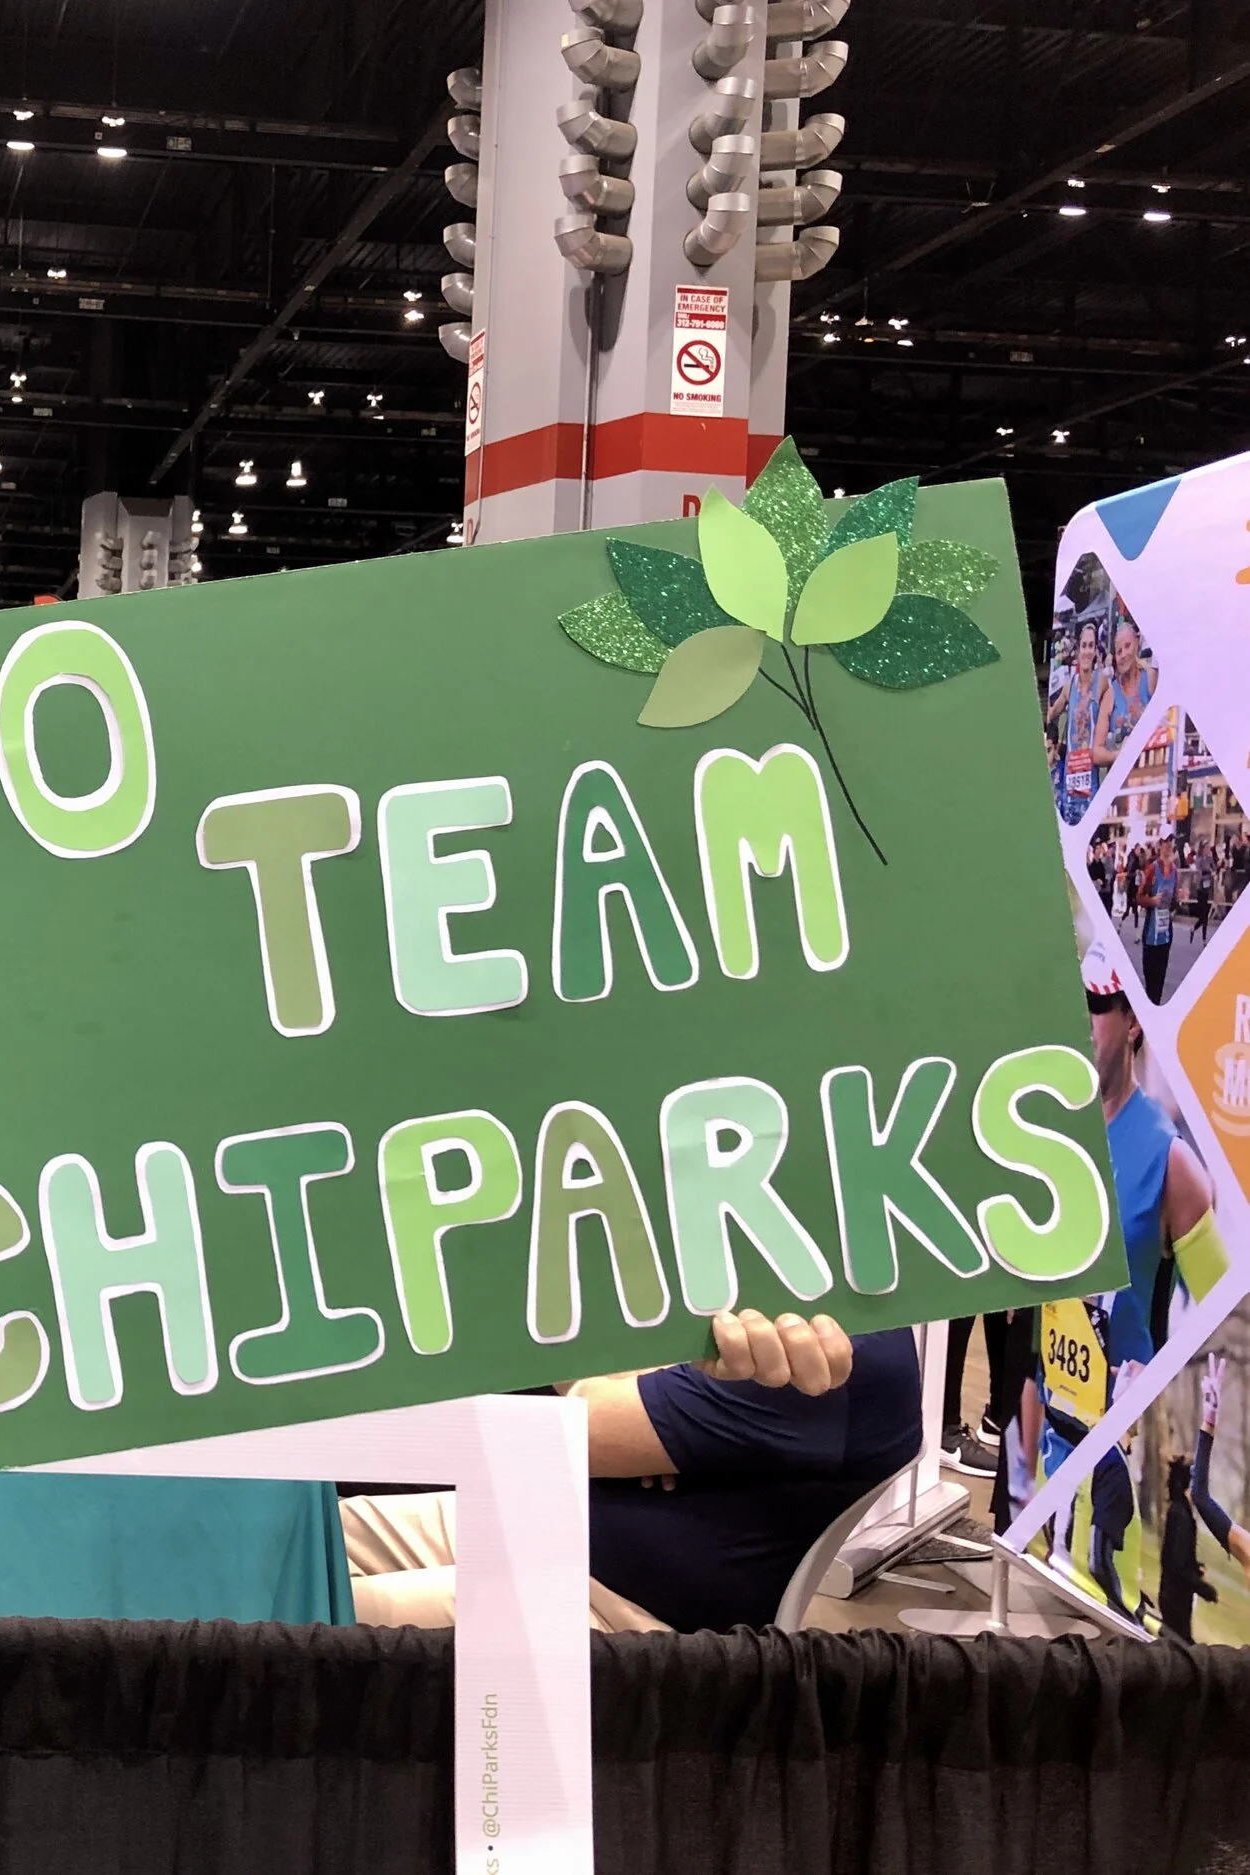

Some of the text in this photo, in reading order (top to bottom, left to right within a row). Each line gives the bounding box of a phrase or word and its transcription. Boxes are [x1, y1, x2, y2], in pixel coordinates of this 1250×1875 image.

[677, 303, 727, 313] EMERGENCY
[680, 294, 724, 305] IN CASE OF
[673, 392, 722, 403] NO SMOKING
[197, 742, 850, 1038] TEAM
[1047, 1328, 1090, 1383] 3483
[481, 1693, 501, 1838] @ChiParksFdn
